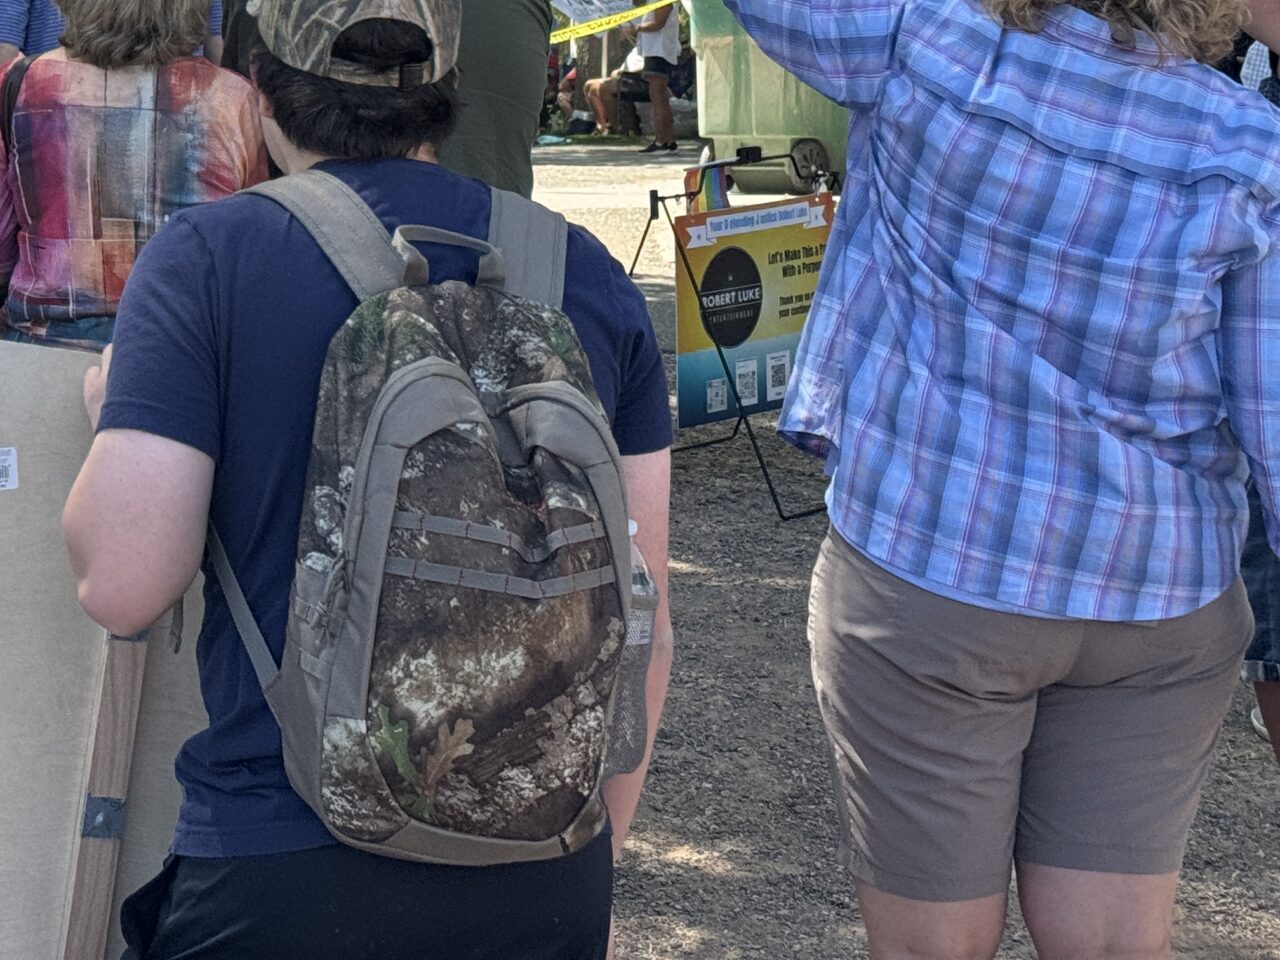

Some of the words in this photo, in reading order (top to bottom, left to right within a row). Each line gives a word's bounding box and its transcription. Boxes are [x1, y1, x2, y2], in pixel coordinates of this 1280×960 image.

[784, 247, 801, 262] Make
[782, 264, 796, 278] With
[702, 291, 736, 308] ROBERT
[738, 288, 761, 302] LUKE
